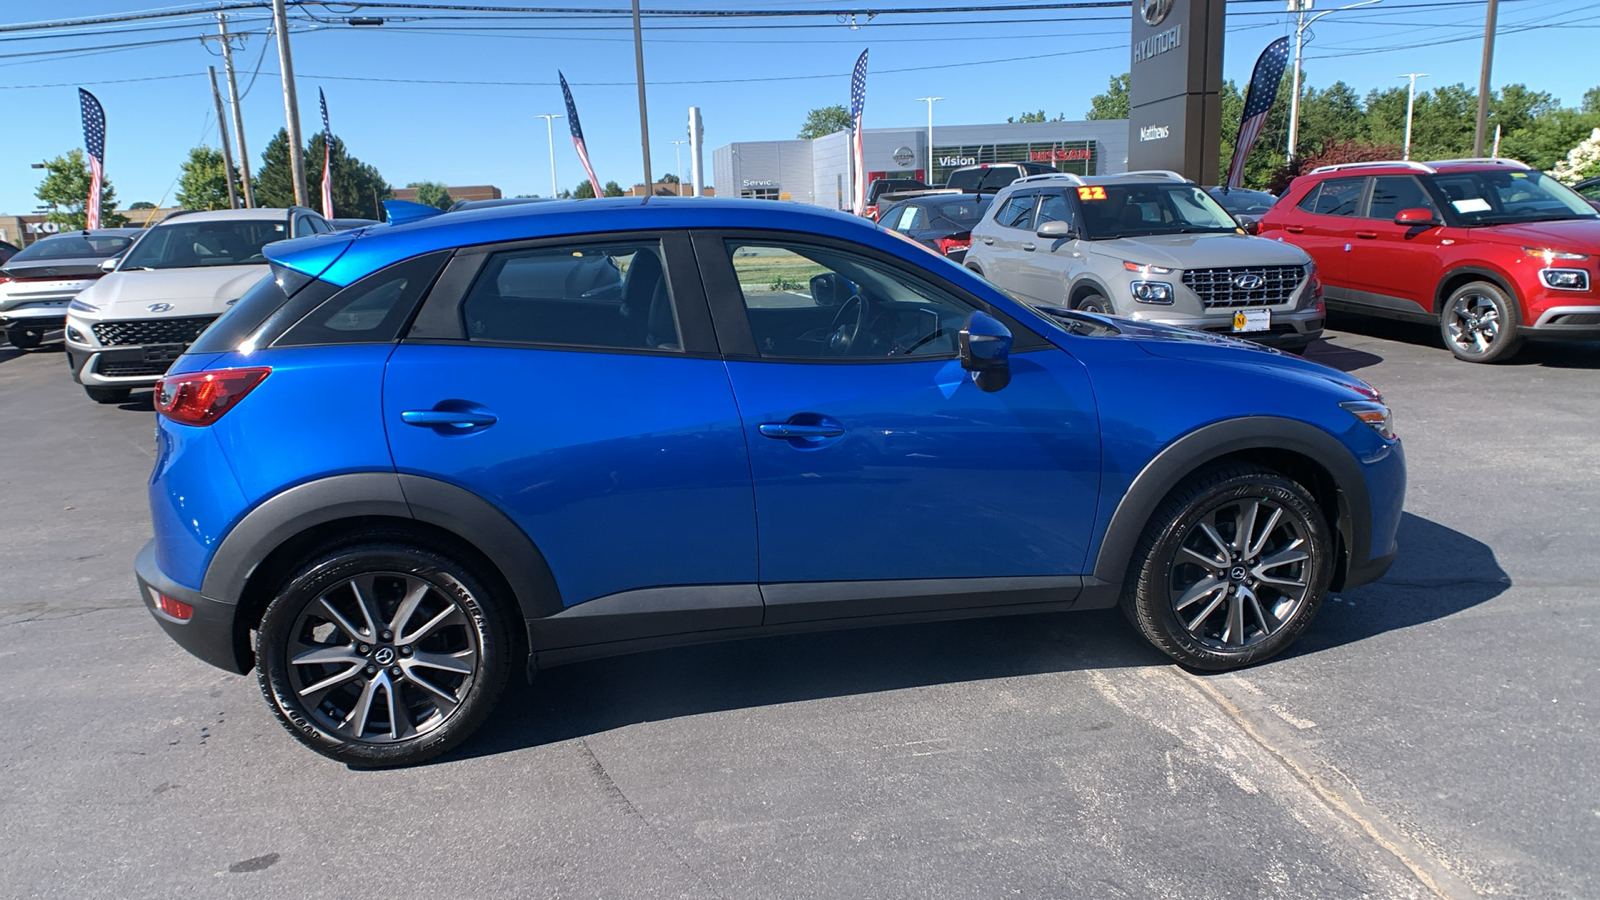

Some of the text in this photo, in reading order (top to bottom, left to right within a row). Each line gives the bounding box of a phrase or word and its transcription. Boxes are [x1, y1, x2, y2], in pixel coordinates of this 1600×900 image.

[1134, 24, 1182, 64] HYUNDAI
[1140, 124, 1169, 141] Matthews
[939, 155, 976, 167] Vision
[1030, 148, 1091, 162] NISSAN
[1079, 186, 1105, 200] 22
